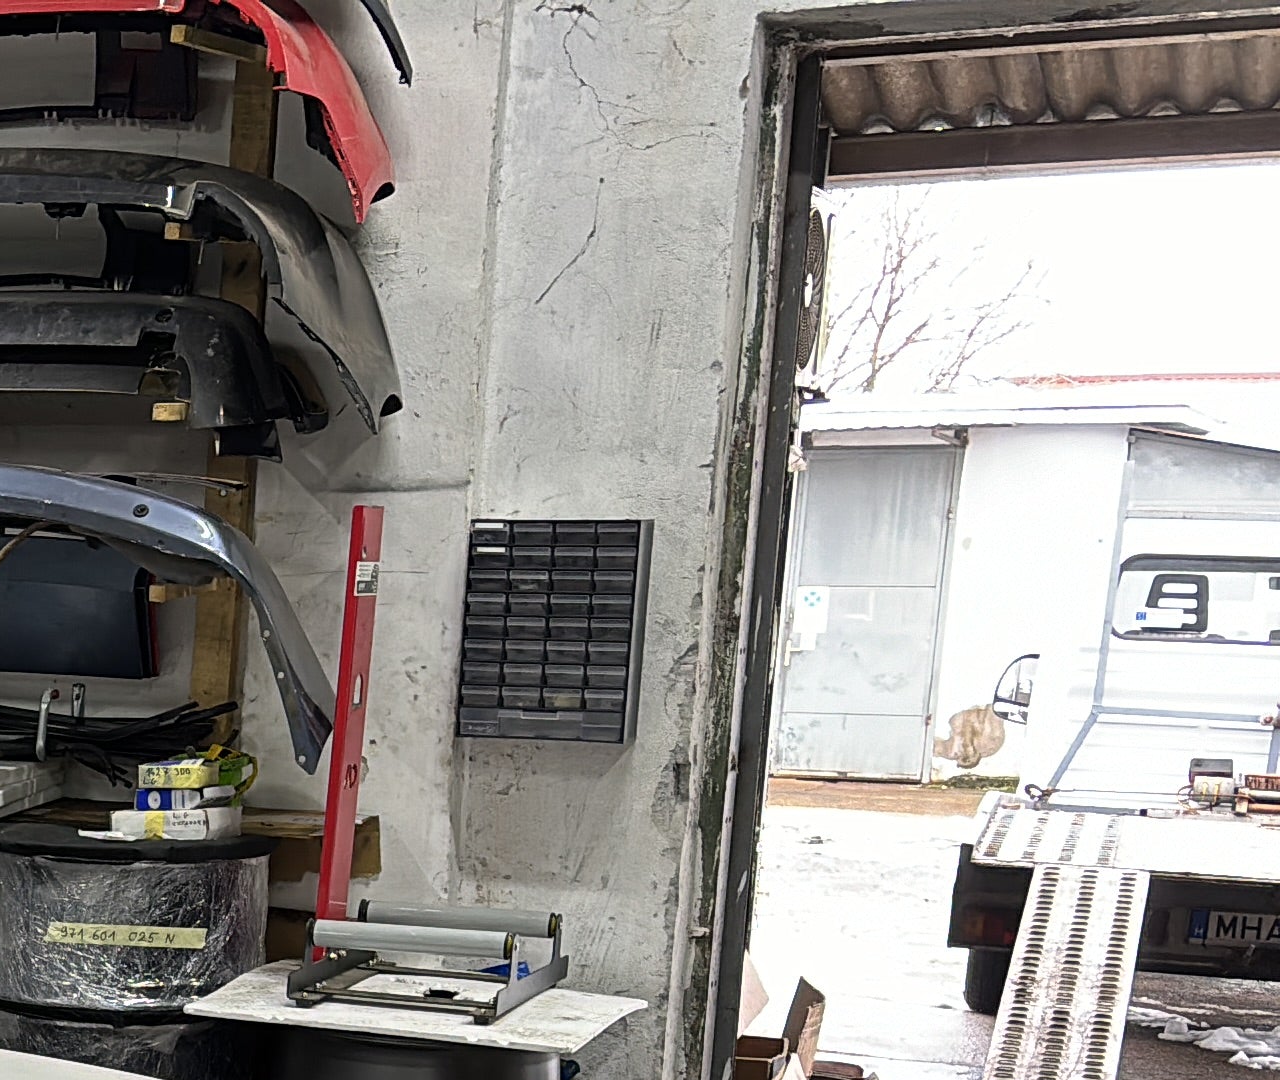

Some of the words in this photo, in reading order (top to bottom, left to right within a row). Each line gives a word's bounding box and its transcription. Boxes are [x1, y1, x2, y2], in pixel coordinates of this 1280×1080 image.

[60, 926, 85, 940] 971
[92, 929, 117, 942] 601
[128, 931, 160, 944] 025
[165, 933, 175, 944] N
